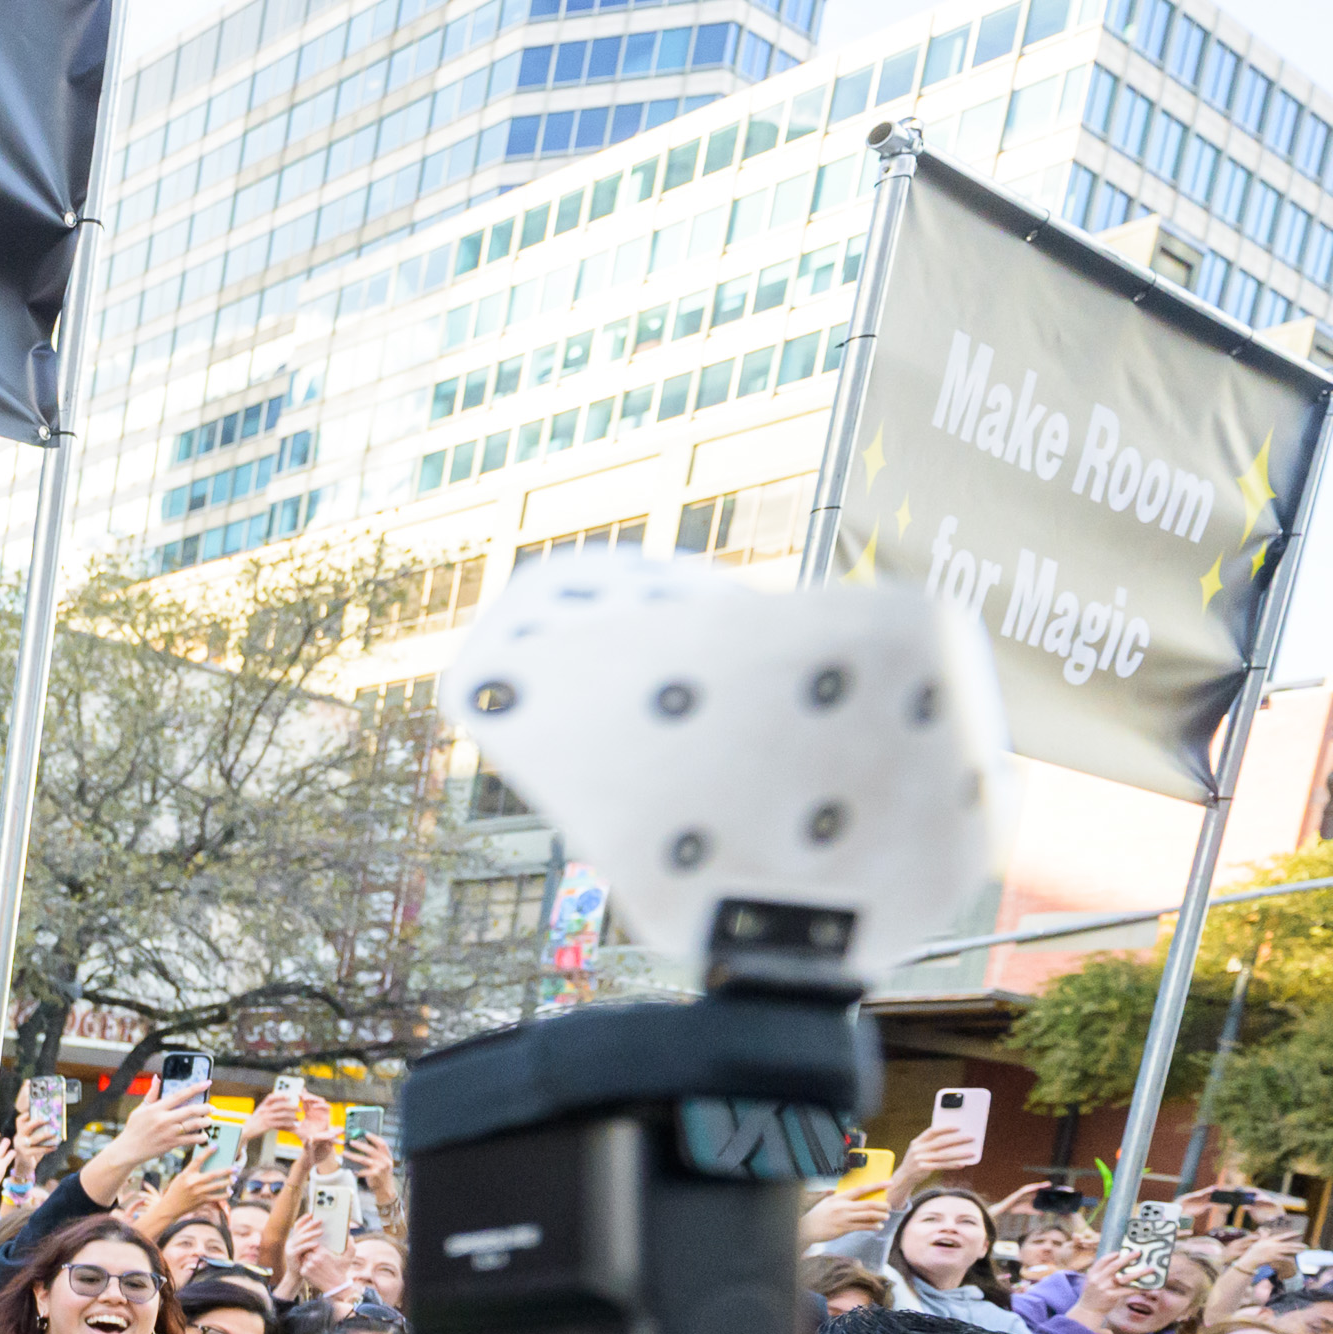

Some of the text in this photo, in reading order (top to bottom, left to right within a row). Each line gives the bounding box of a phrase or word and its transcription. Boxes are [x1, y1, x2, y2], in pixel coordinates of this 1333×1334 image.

[931, 330, 1215, 544] Make Room
[924, 514, 1151, 685] for Magic
